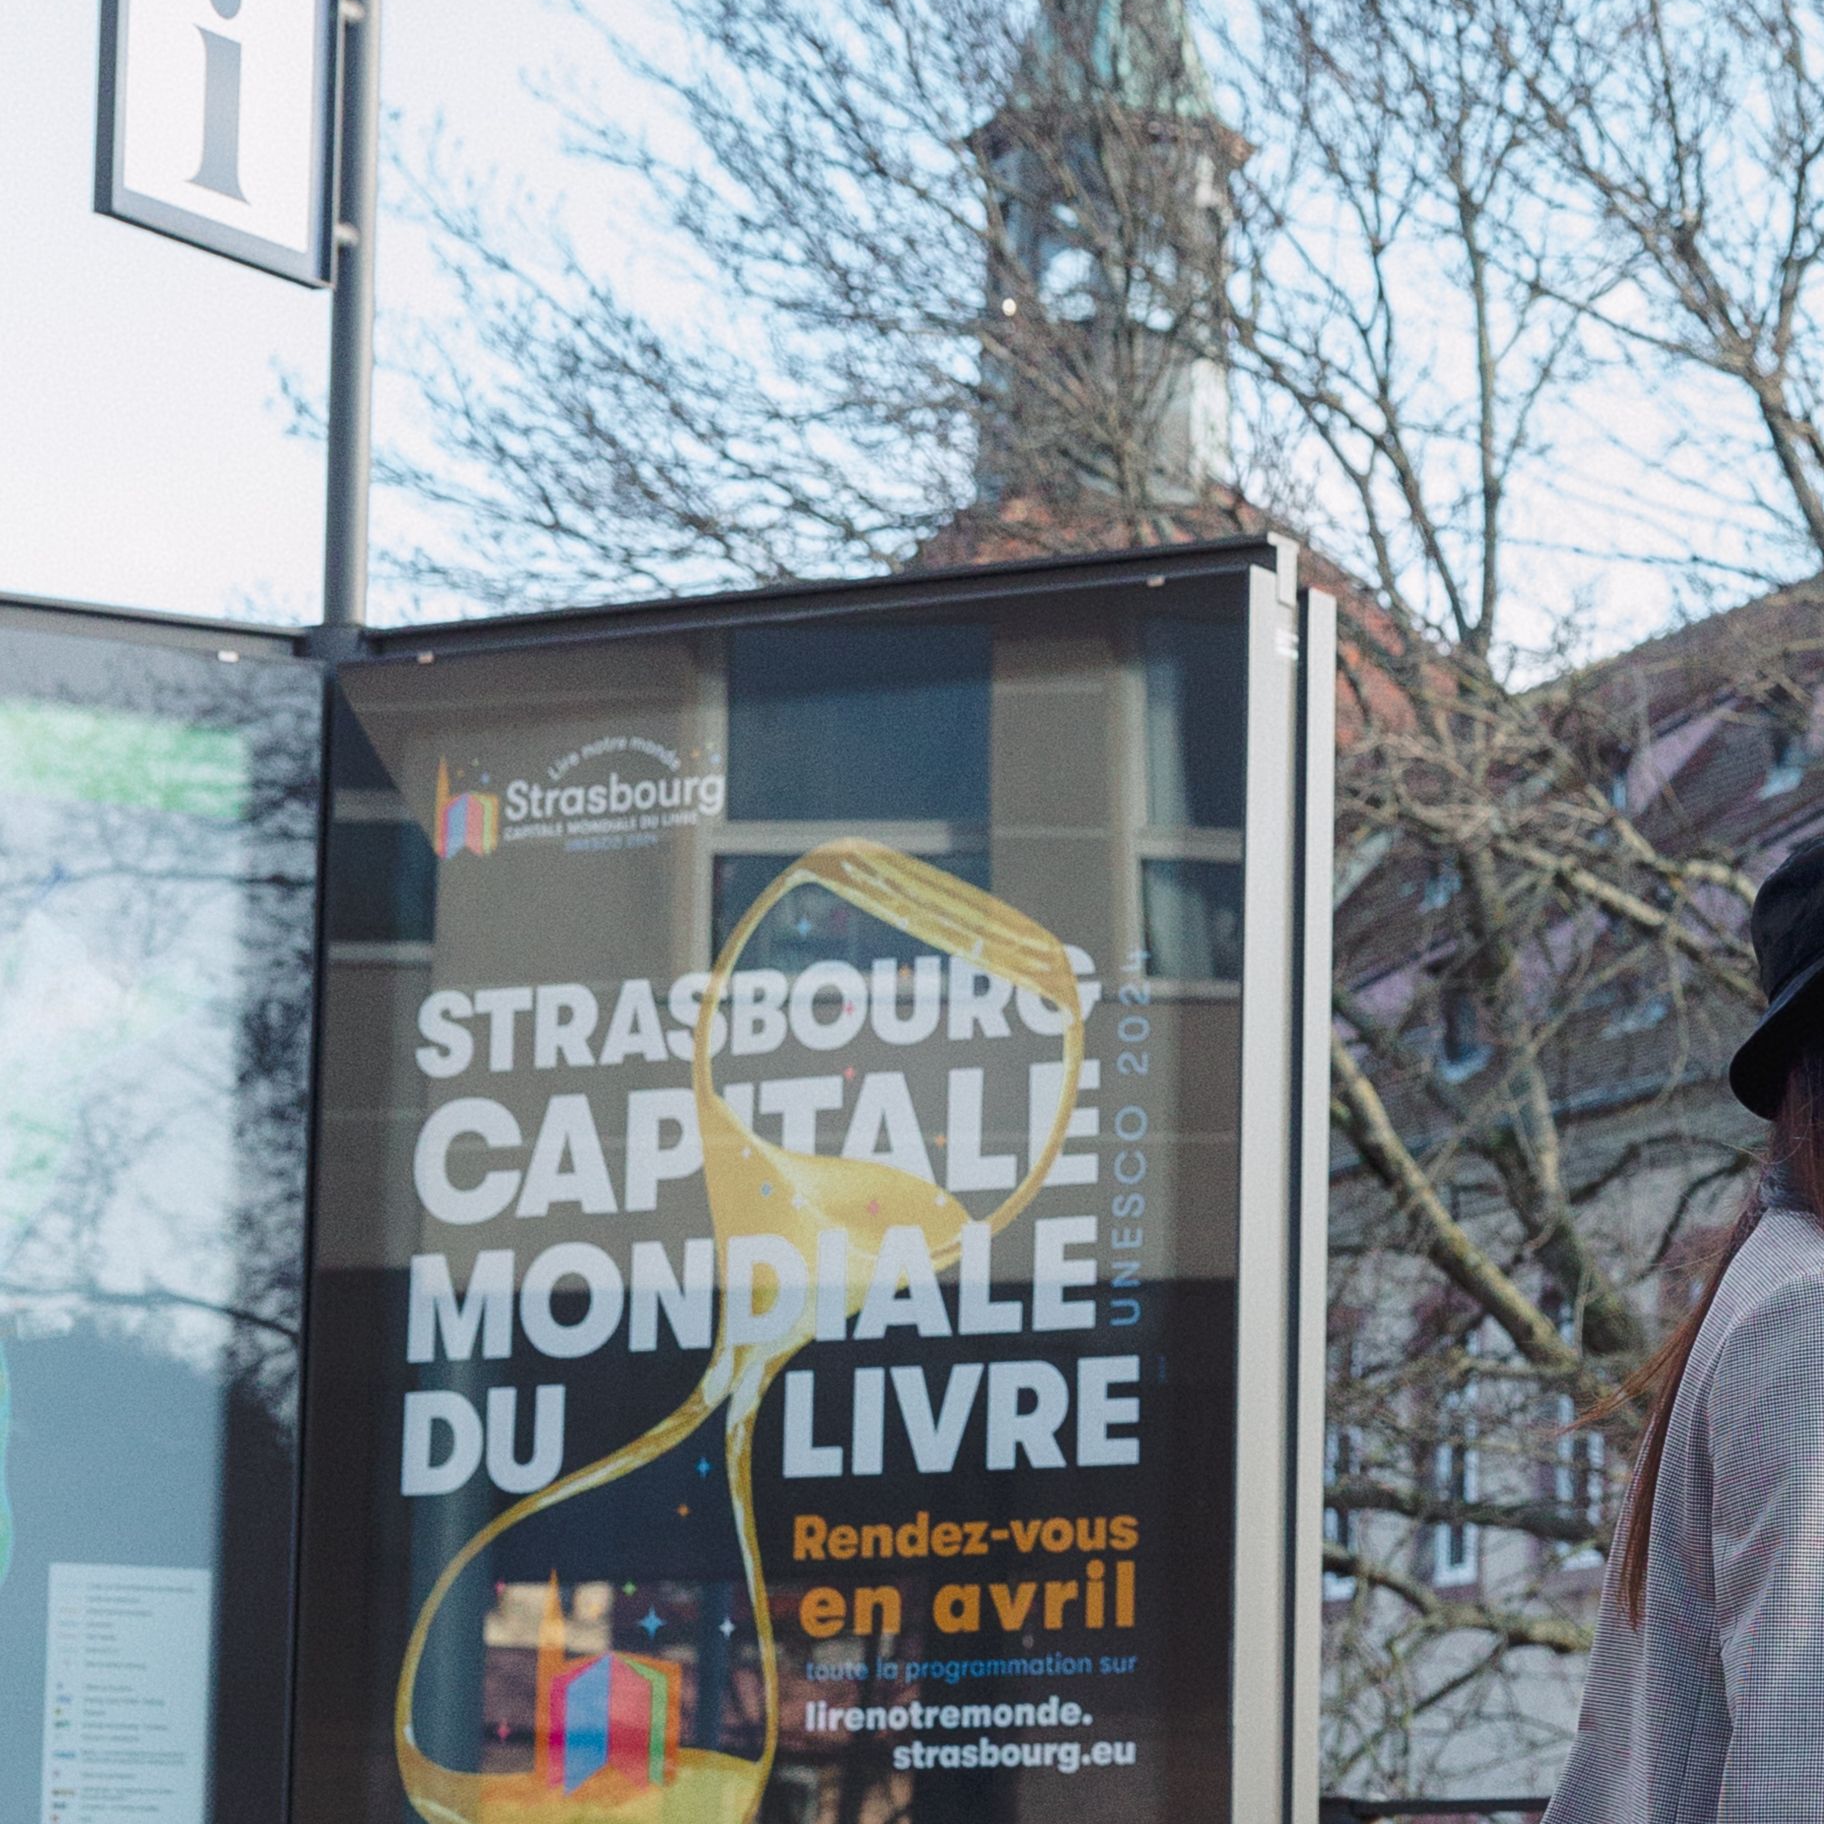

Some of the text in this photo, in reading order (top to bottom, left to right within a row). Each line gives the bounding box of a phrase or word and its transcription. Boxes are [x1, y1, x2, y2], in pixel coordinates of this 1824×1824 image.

[504, 772, 726, 818] Strasbourg
[414, 944, 1103, 1078] STRASBOURG
[413, 1059, 1101, 1226] CAPTALE
[1110, 948, 1152, 1328] UNESCO 2024
[407, 1215, 1098, 1364] MONDIALE
[401, 1354, 1141, 1497] DU LIVRE
[792, 1510, 1140, 1561] Rendez-vous
[800, 1558, 1137, 1638] en avril
[805, 1651, 1138, 1684] toute la programmation sur
[804, 1694, 1094, 1732] lirenotremonde.
[892, 1737, 1137, 1774] strasbourg.eu
